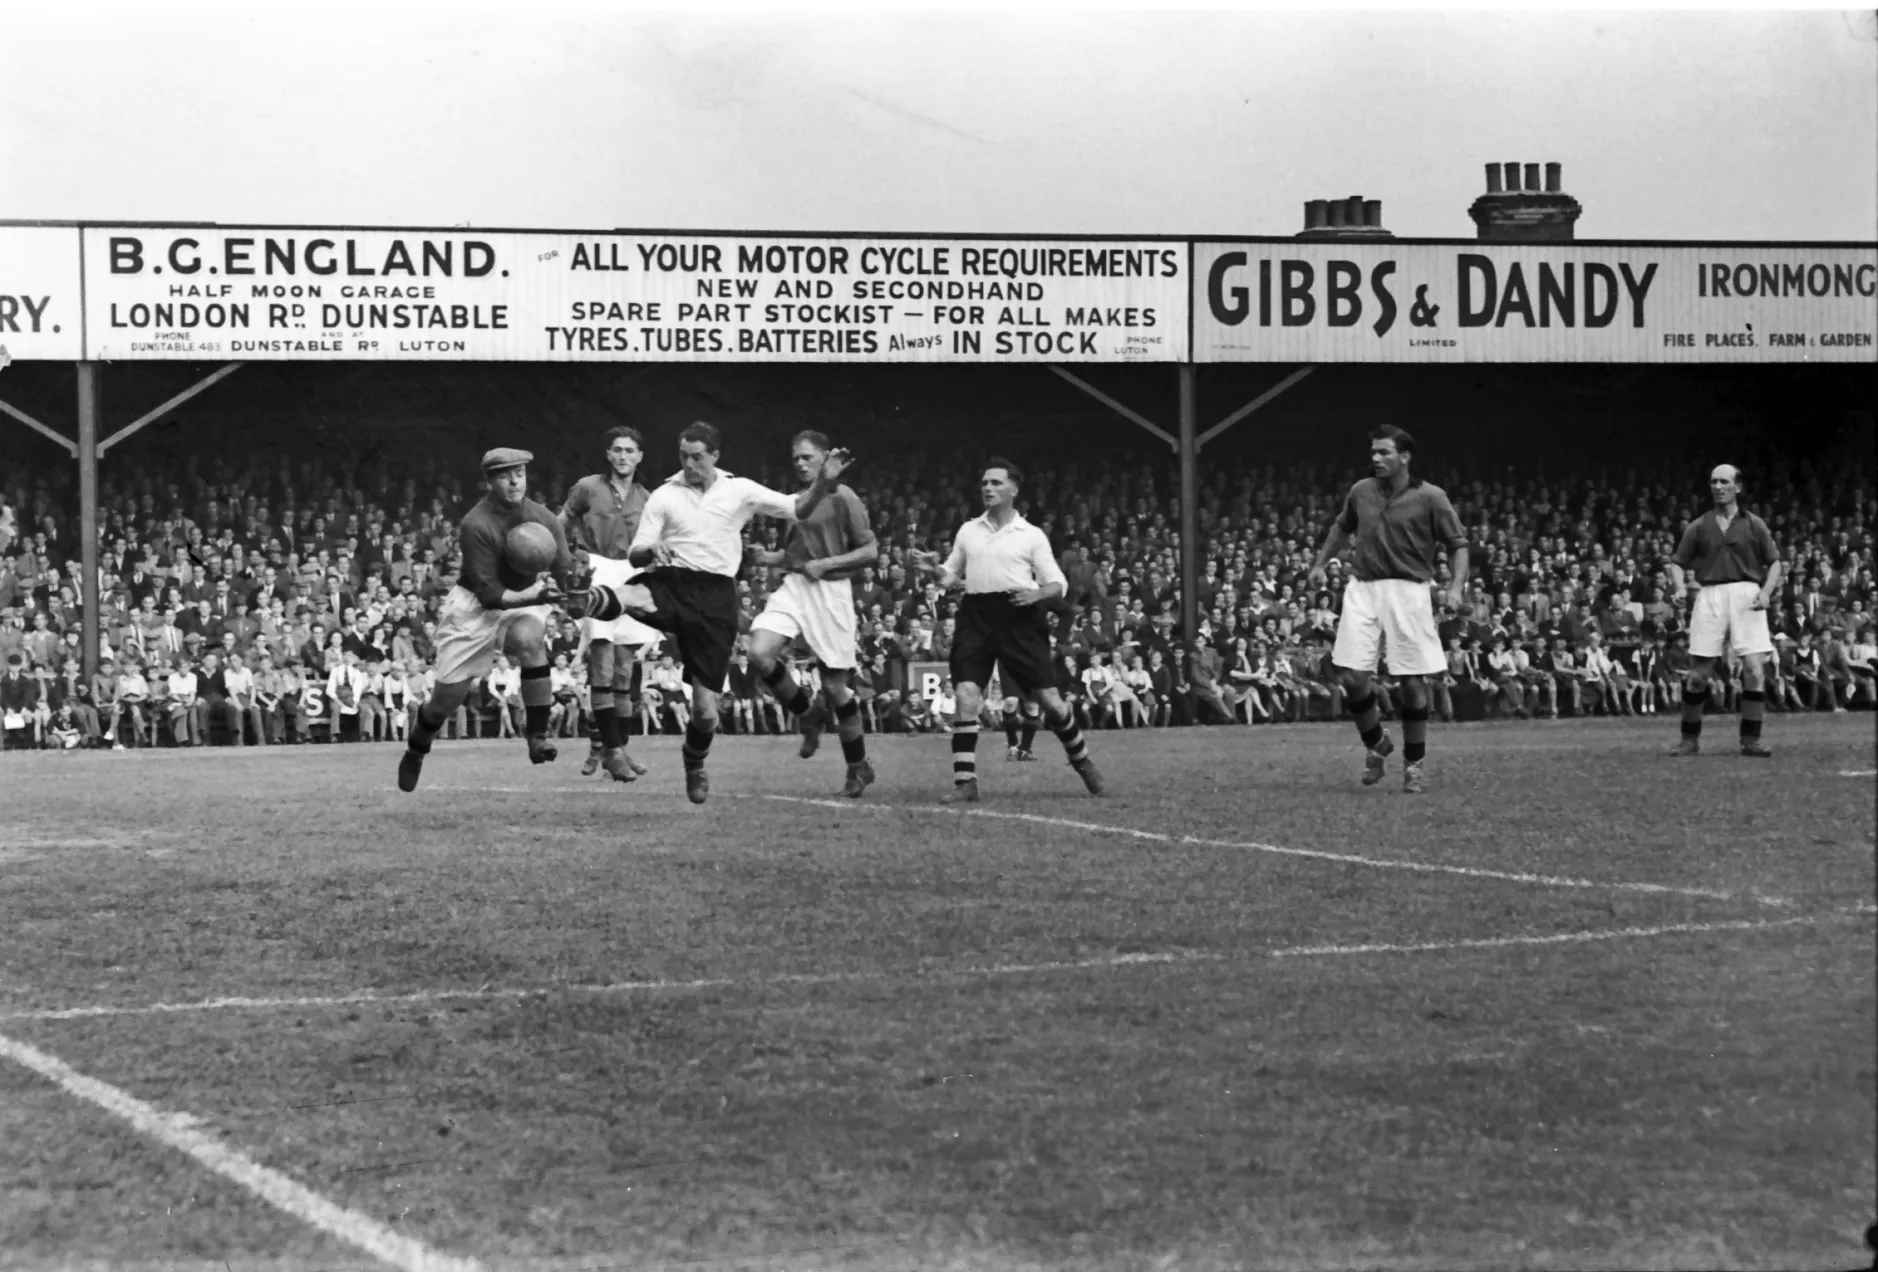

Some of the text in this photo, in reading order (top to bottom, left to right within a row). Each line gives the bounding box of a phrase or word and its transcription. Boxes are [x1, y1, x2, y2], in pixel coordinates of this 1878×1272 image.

[571, 243, 1177, 279] ALL YOUR MOTOR CYCLE REQUIREMENTS
[169, 284, 436, 299] HALF MOON GARAGE
[698, 279, 1043, 301] NEW AND SECONDHAND
[1699, 264, 1876, 297] IRONMONG
[1208, 251, 1658, 338] GIBBS & DANDY
[111, 303, 249, 328] LONDON
[323, 304, 508, 329] DUNSTABLE
[572, 302, 661, 321] SPARE
[679, 303, 751, 322] PART
[765, 304, 893, 324] STOCKIST
[934, 306, 984, 324] FOR
[998, 307, 1050, 326] ALL
[1066, 308, 1155, 327] MAKES
[131, 342, 194, 352] DUNSTABLE
[154, 331, 190, 341] PHONE
[230, 340, 343, 352] DUNSTABLE
[399, 340, 465, 352] LUTON
[954, 331, 980, 354] IN
[996, 331, 1097, 354] STOCK
[1126, 336, 1162, 345] PHONE
[1409, 339, 1457, 348] LIMITED
[1663, 333, 1696, 348] FIRE
[1769, 333, 1806, 347] FARM
[1819, 332, 1872, 347] GARDEN
[923, 672, 941, 700] B
[305, 687, 324, 716] S
